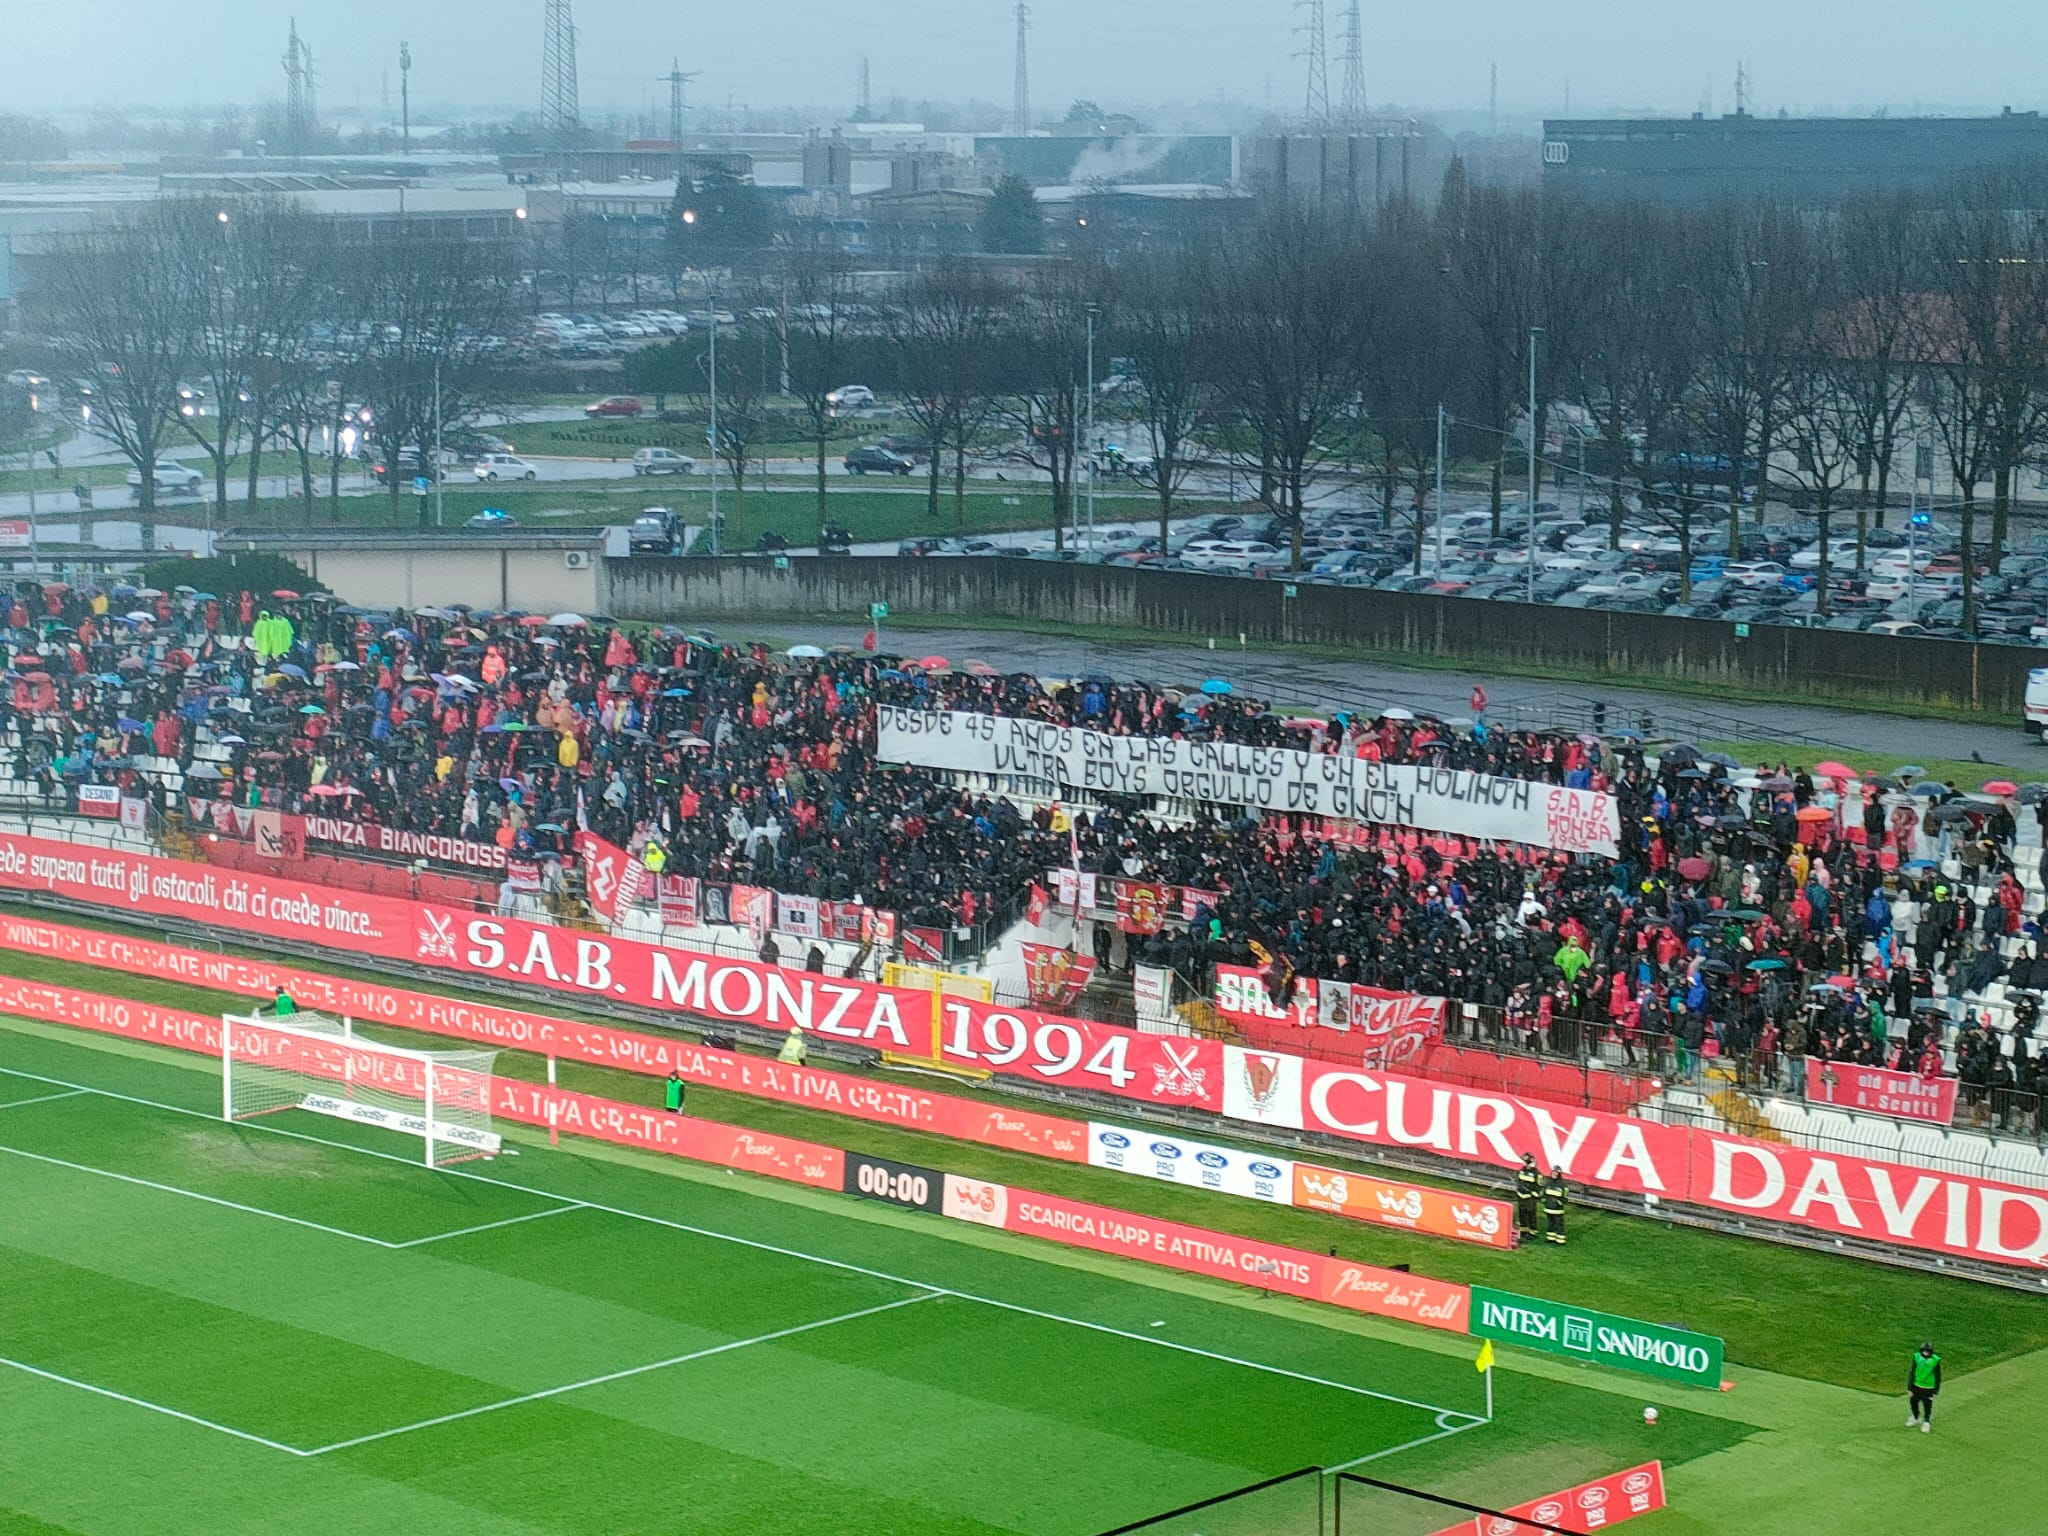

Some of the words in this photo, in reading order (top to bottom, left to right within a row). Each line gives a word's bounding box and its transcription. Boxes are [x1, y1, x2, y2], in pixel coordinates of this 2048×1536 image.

[879, 706, 952, 735] DESDE
[965, 715, 995, 741] 45
[1127, 738, 1177, 765] LAS
[1189, 741, 1284, 777] CALLES
[1294, 751, 1311, 782] Y
[1366, 760, 1398, 791] EL
[995, 744, 1070, 783] ULTRA
[1085, 760, 1147, 792] BOYS
[1164, 770, 1272, 805] ORGULLO
[1288, 782, 1318, 811] DE
[304, 816, 367, 846] MONZA
[30, 855, 86, 888] supera
[91, 858, 125, 891] tutti
[130, 862, 149, 903] gli
[152, 873, 219, 910] ostacoli,
[223, 879, 248, 913] chi
[251, 887, 267, 917] ci
[271, 892, 320, 927] crede
[467, 919, 627, 995] S.A.B.
[651, 950, 909, 1047] MONZA
[941, 1002, 1135, 1088] 1994
[1105, 1151, 1124, 1163] PRO
[1308, 1070, 1664, 1192] CURVA
[858, 1164, 928, 1205] 00:00
[1156, 1161, 1175, 1173] PRO
[1202, 1170, 1221, 1182] PRO
[1255, 1181, 1274, 1193] PRO
[1019, 1203, 1096, 1236] SCARICA
[1100, 1220, 1150, 1247] L'APP
[1154, 1232, 1166, 1251] E
[1170, 1237, 1236, 1267] ATTIVA
[1240, 1252, 1310, 1284] GRATIS
[1332, 1268, 1388, 1296] Please
[1384, 1287, 1425, 1306] don't
[1418, 1295, 1461, 1320] call
[1482, 1301, 1557, 1341] INTESA
[1597, 1326, 1709, 1374] SANPAOLO
